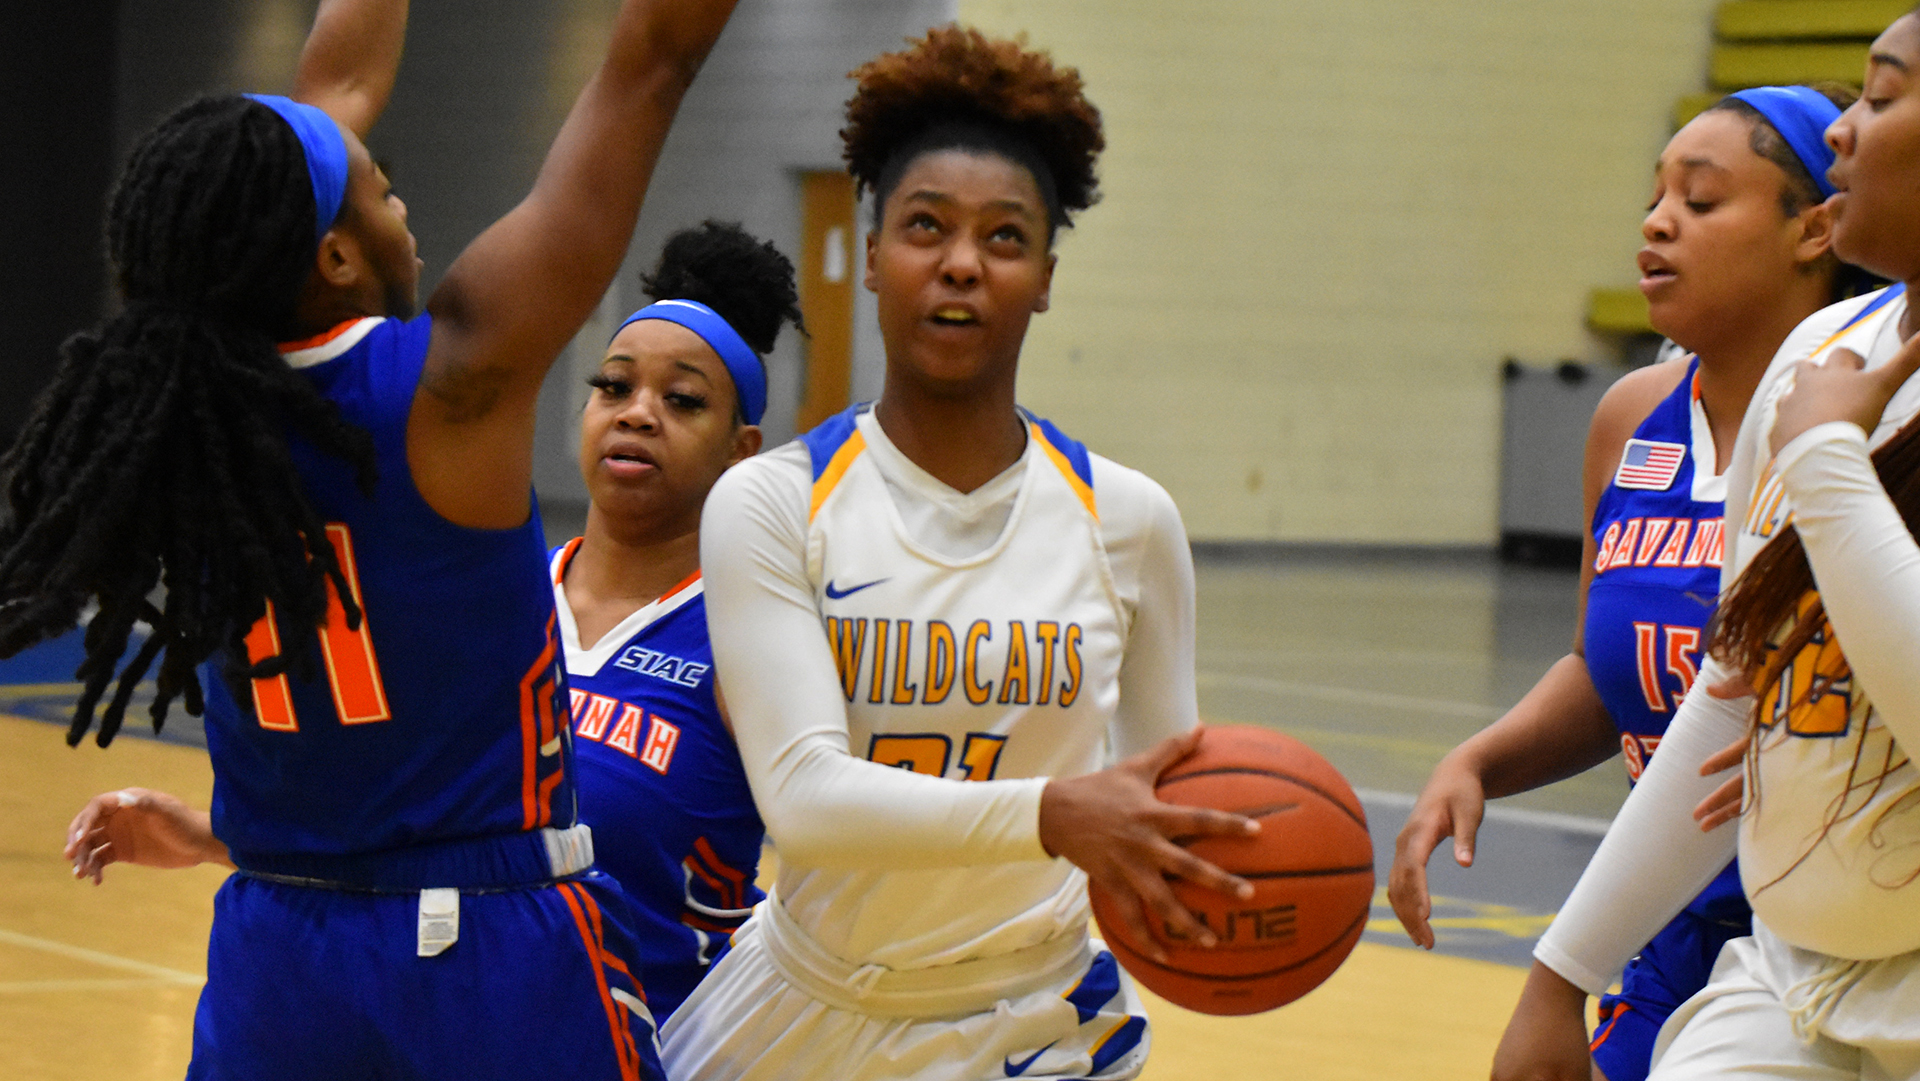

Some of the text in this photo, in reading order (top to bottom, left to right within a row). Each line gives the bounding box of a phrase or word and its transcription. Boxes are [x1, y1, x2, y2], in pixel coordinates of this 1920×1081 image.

[613, 645, 711, 688] SIAC
[826, 615, 1083, 708] WILDCATS
[1633, 620, 1701, 713] 15
